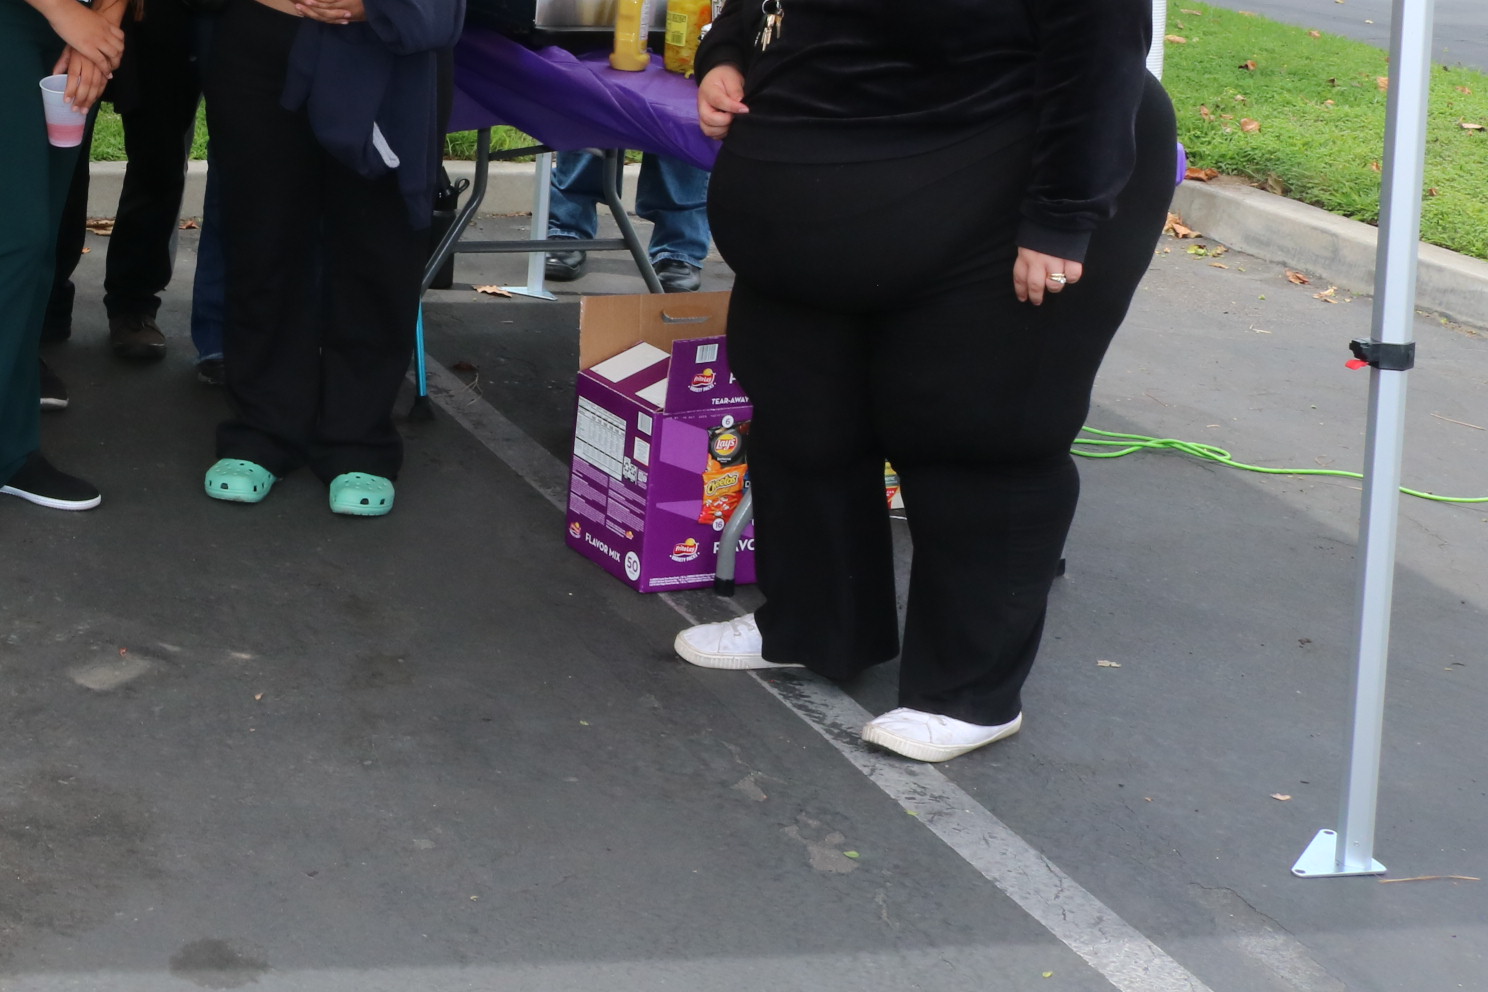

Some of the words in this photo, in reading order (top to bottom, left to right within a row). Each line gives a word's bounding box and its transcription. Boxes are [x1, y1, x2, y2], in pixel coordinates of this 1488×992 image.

[712, 395, 750, 405] TEAR-AWAY
[715, 520, 723, 528] 16
[585, 532, 609, 555] FLAVOR
[608, 548, 621, 562] MIX
[626, 556, 639, 573] 50
